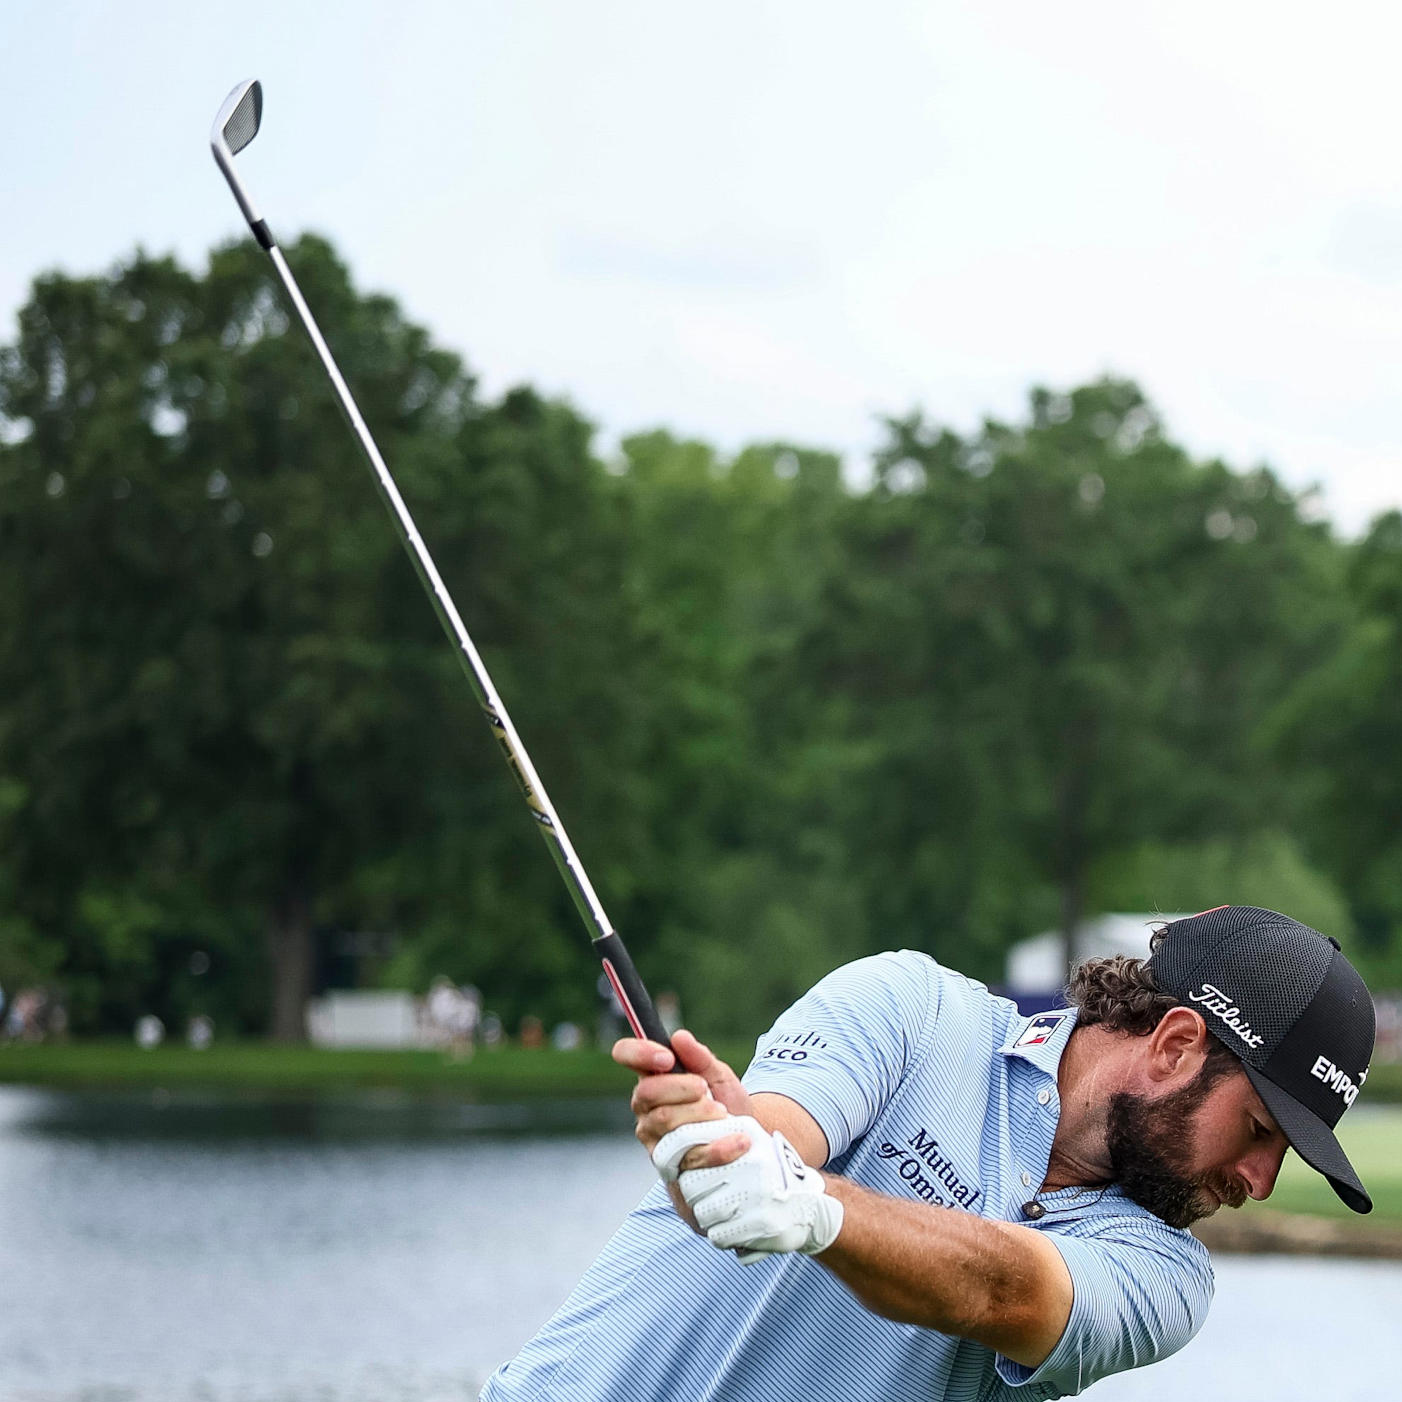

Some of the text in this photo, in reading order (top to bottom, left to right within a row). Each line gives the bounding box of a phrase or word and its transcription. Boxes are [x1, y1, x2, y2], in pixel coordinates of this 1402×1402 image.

[1189, 984, 1264, 1048] Titleist
[1310, 1055, 1360, 1109] EMPO
[876, 1142, 955, 1210] of Oma
[907, 1127, 980, 1210] Mutual
